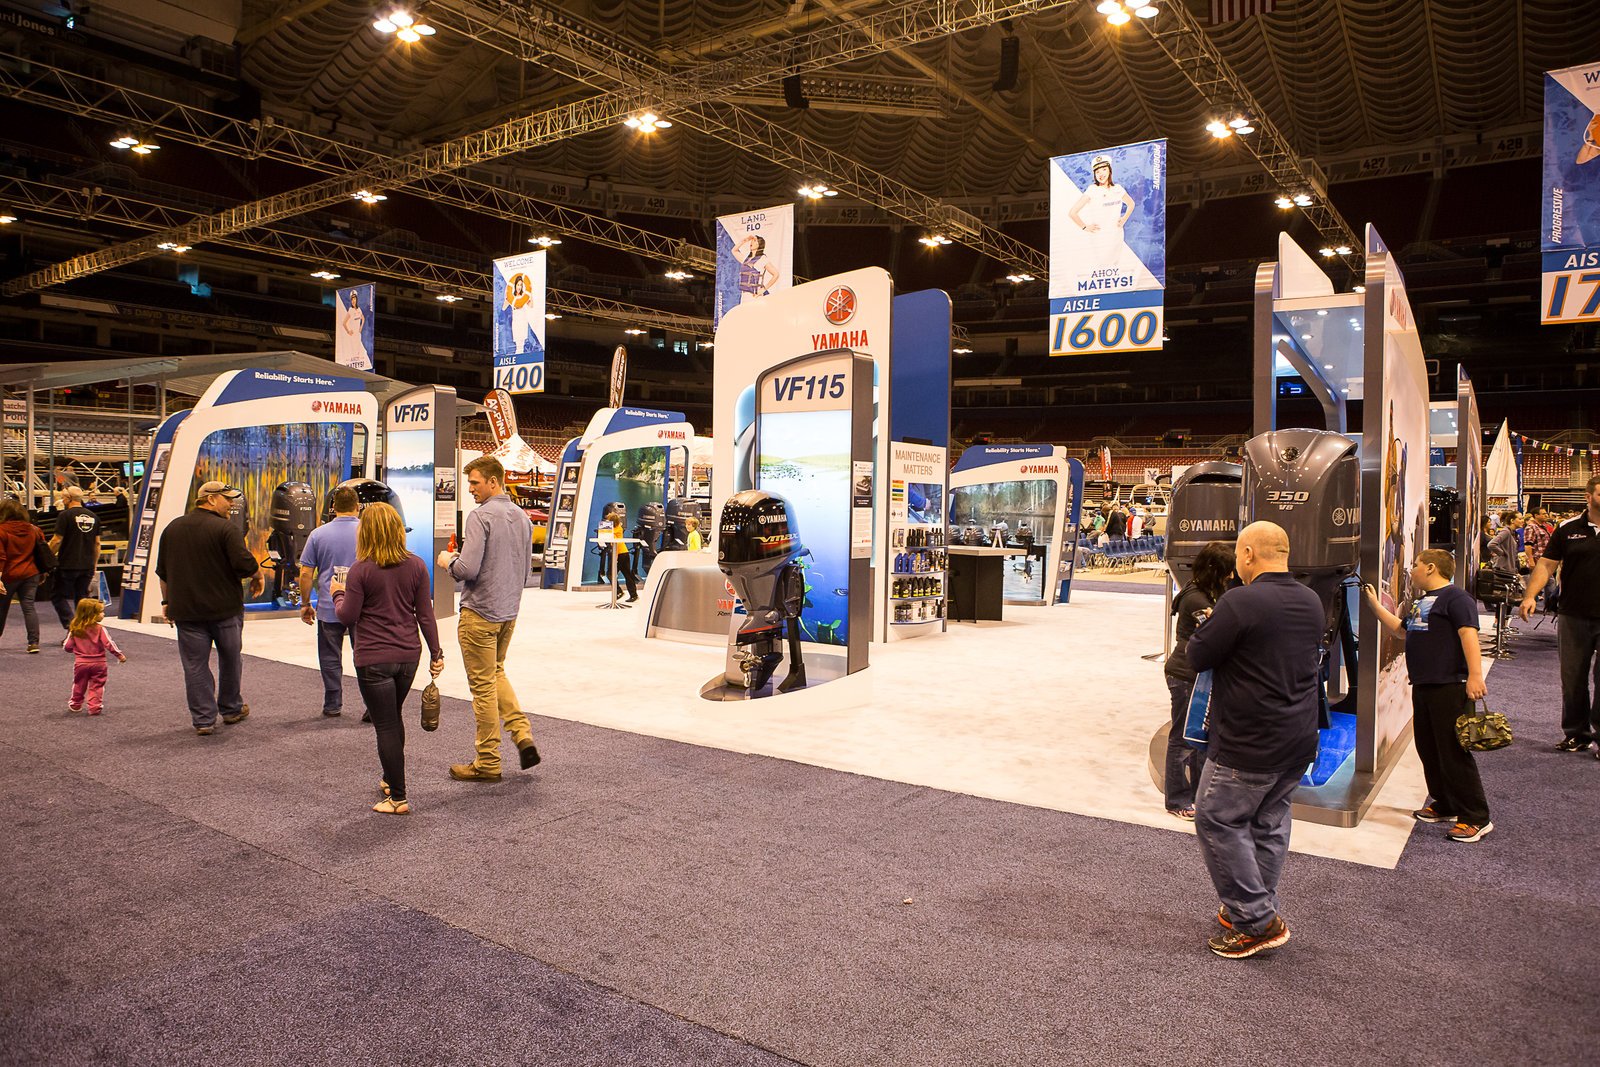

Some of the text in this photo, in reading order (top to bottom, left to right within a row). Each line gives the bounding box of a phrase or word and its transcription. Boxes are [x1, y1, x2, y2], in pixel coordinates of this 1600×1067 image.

[17, 14, 55, 36] Jones
[1498, 138, 1522, 150] 428
[1364, 157, 1385, 170] 427
[648, 198, 664, 208] 420
[1037, 201, 1048, 211] 42
[841, 208, 858, 217] 422
[1552, 188, 1563, 243] PROGRESSIVE
[746, 222, 760, 232] FLO
[504, 256, 533, 268] WELCOME
[1078, 276, 1133, 291] MATEYS!
[1063, 299, 1100, 312] AISLE
[1053, 310, 1158, 351] 1600
[812, 330, 868, 350] YAMAHA
[500, 356, 516, 366] AISLE
[255, 372, 291, 383] Reliability
[293, 375, 314, 385] Starts
[496, 365, 542, 390] 1400
[775, 374, 845, 401] VF115
[323, 401, 362, 415] YAMAHA
[394, 404, 429, 423] VF175
[664, 430, 686, 440] YAMAHA
[895, 449, 941, 464] MAINTENANCE
[903, 464, 933, 475] MATTERS
[1028, 465, 1059, 474] YAMAHA
[1266, 490, 1310, 502] 350
[766, 514, 787, 524] YAMAHA
[1190, 519, 1236, 532] YAMAHA
